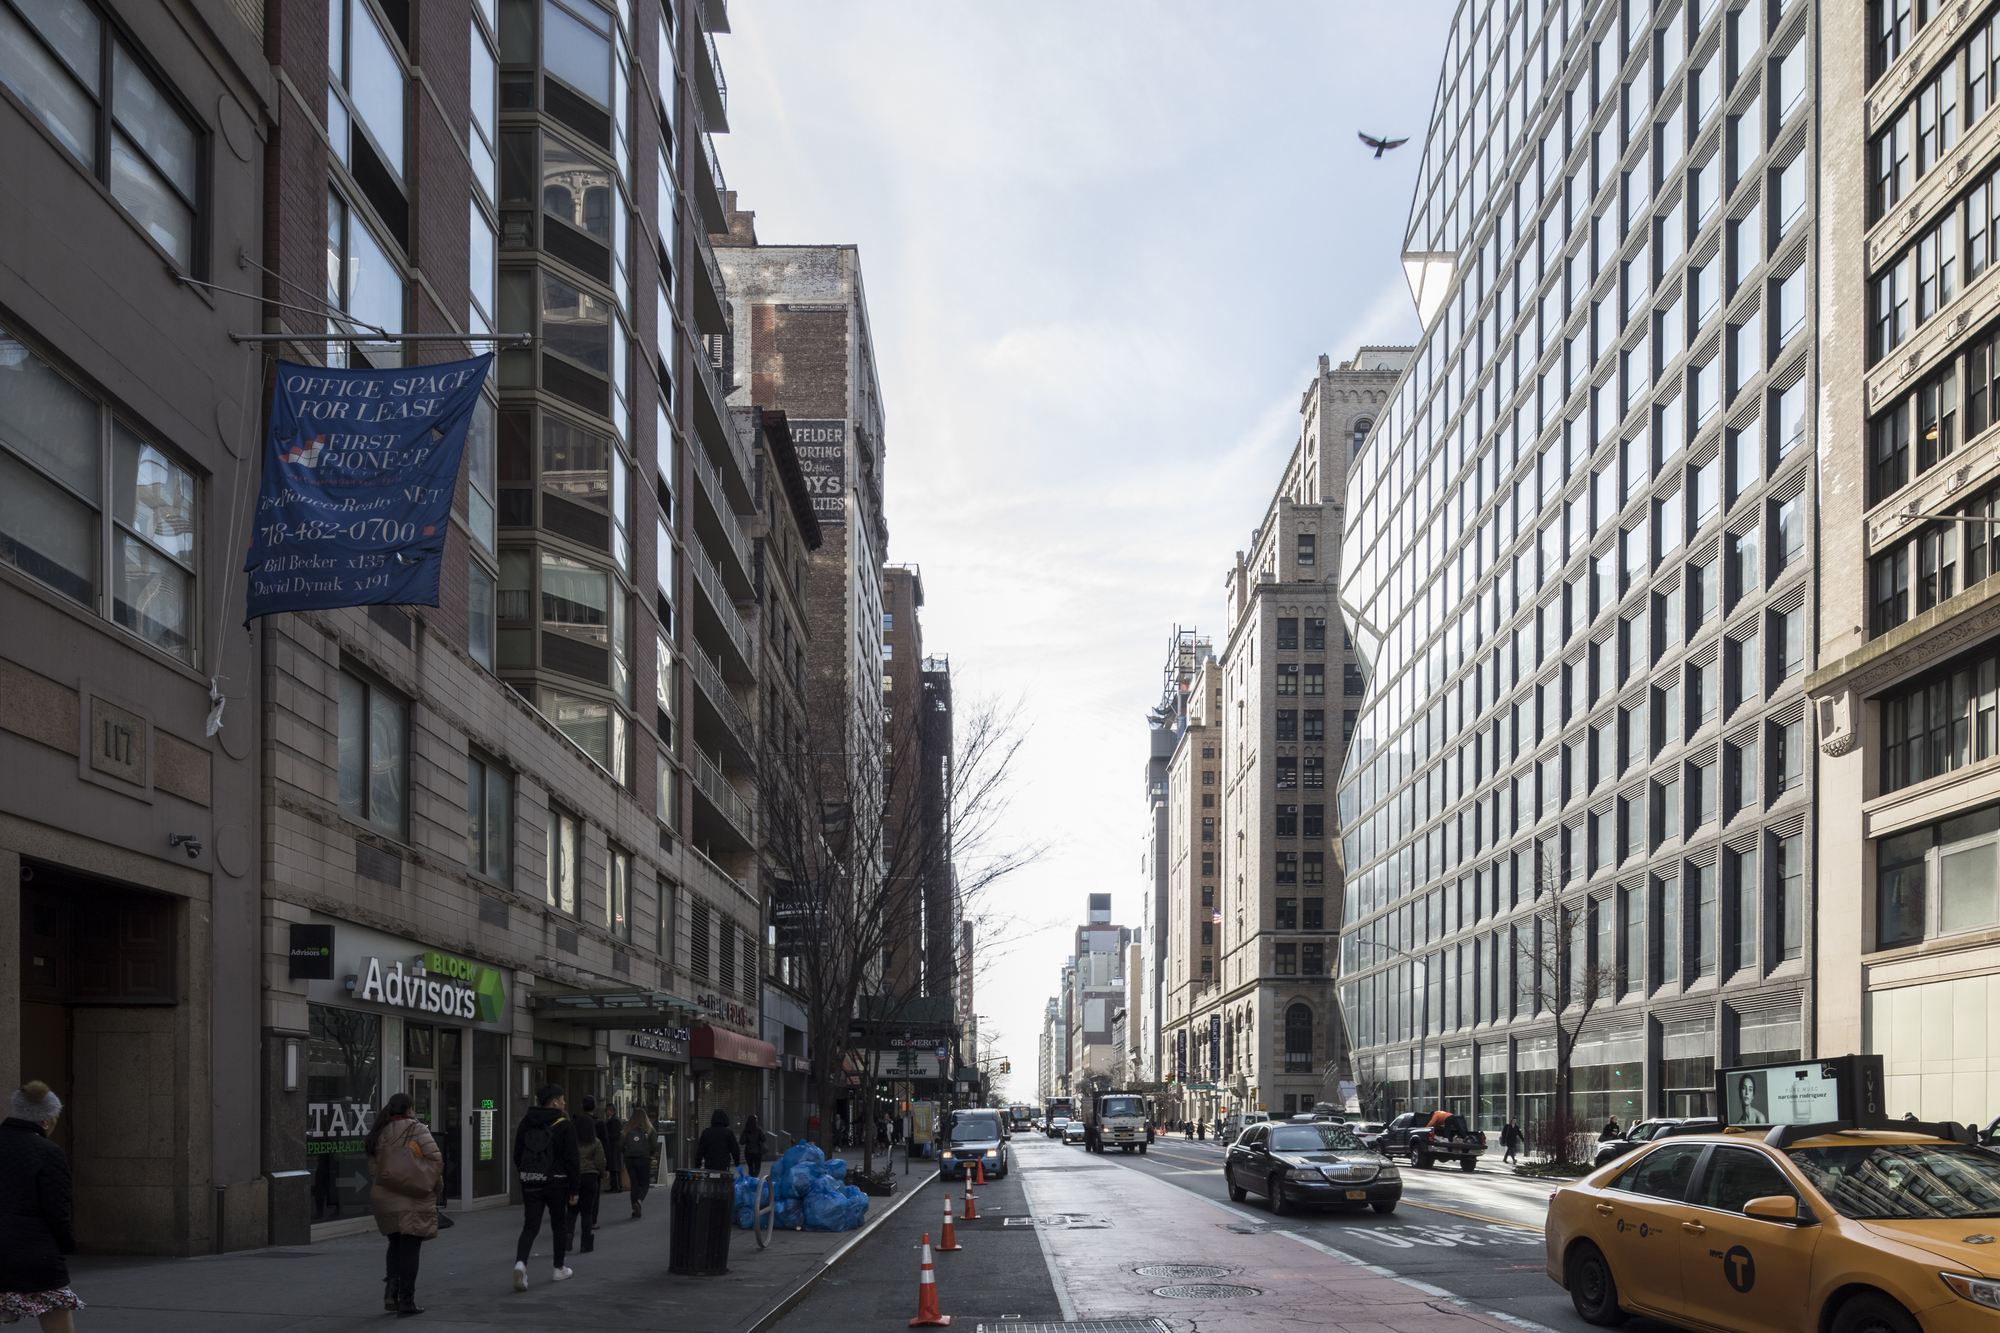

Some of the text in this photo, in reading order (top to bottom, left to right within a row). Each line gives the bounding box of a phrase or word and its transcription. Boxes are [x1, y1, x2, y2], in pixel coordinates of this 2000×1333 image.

[287, 368, 475, 399] OFFICE SPACE
[296, 397, 445, 423] FOR LEASE
[328, 433, 402, 450] FIRST
[790, 428, 843, 442] LFELDER
[261, 517, 416, 548] 718-482-0700
[264, 554, 386, 573] Bill Becker x135
[254, 573, 389, 597] David Dynak x191
[429, 952, 476, 983] BLOCK
[357, 956, 476, 1020] Advisors
[481, 1099, 494, 1109] OPEN
[308, 1103, 371, 1137] TAX
[307, 1140, 366, 1155] PREPARATIO
[1709, 1249, 1748, 1287] NYC T
